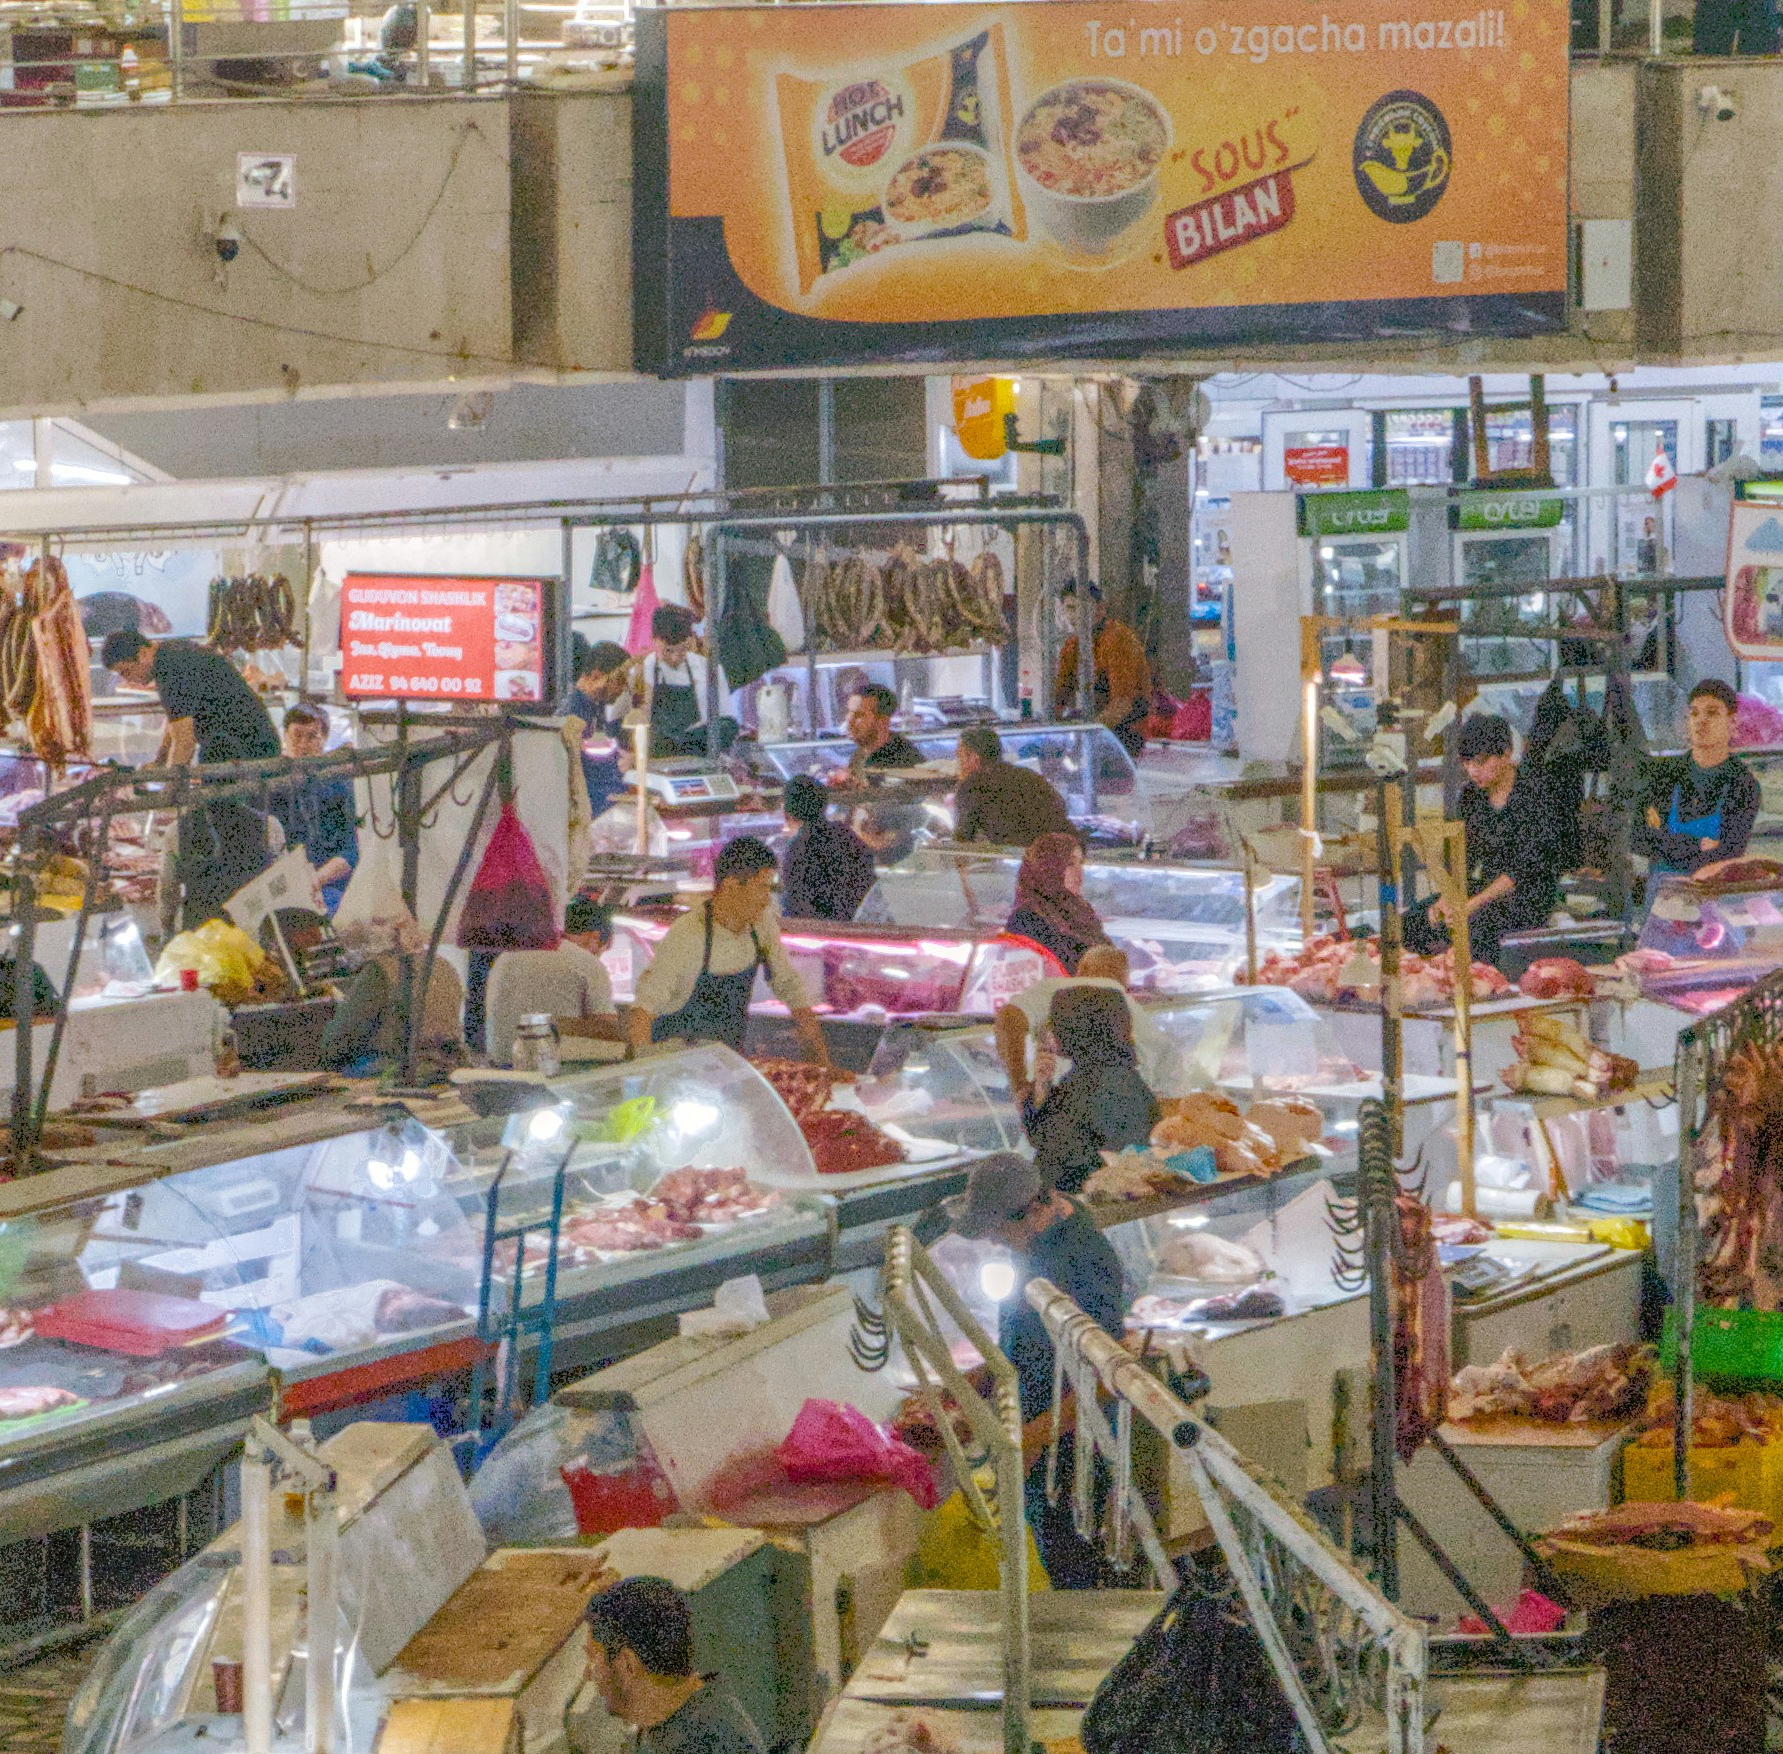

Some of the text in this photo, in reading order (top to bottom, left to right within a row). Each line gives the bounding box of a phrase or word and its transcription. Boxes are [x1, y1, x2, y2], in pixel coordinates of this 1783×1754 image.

[1086, 10, 1505, 63] Ta'mi o'zgacha mazali!
[821, 94, 905, 157] LUNCH
[1174, 179, 1283, 256] BILAN
[421, 590, 487, 606] SHASHLIK
[348, 610, 453, 632] Marinovat
[349, 674, 384, 690] AZIZ
